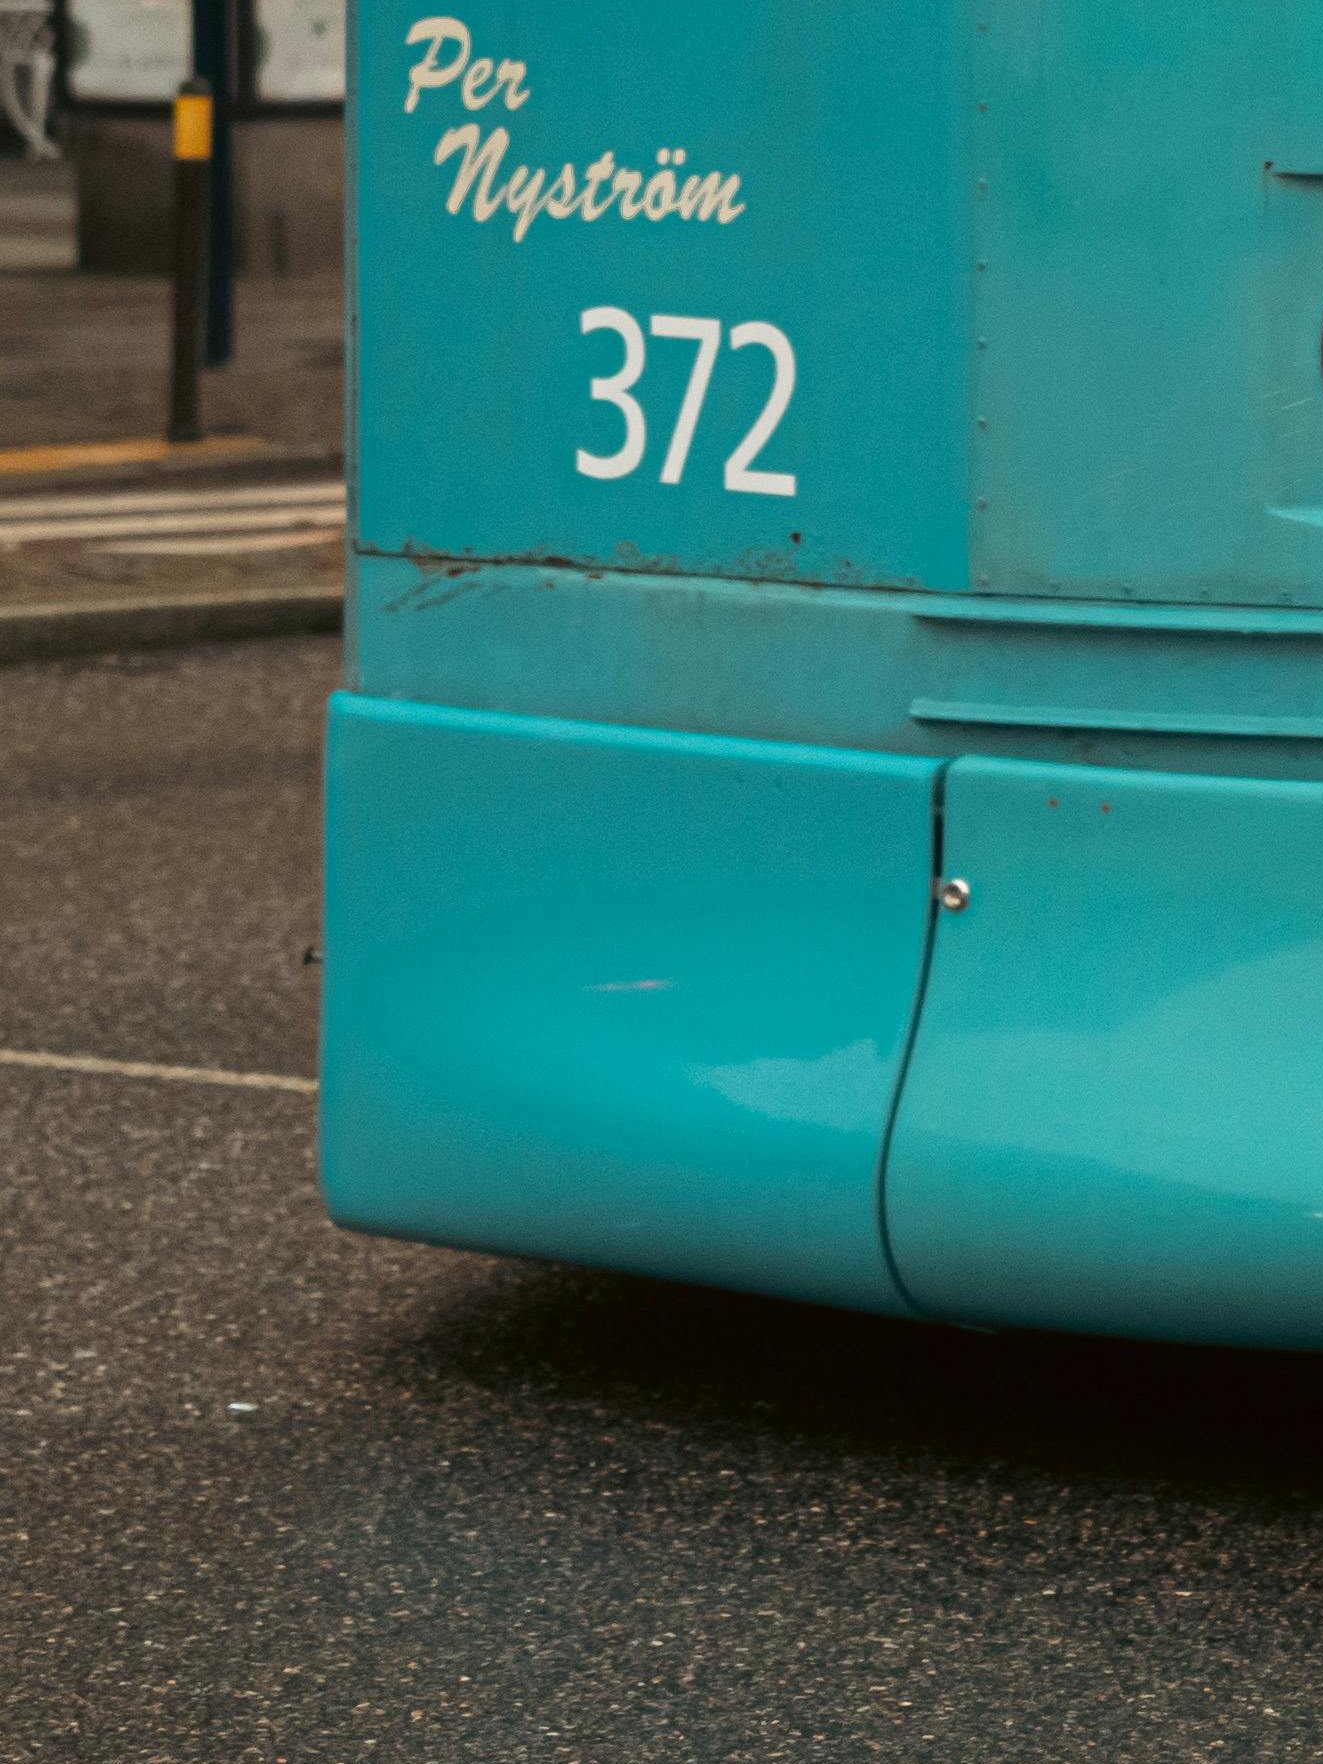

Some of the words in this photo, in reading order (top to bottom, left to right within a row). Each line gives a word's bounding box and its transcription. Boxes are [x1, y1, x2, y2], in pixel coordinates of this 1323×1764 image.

[404, 16, 530, 113] Per
[434, 123, 745, 242] Nyström
[576, 306, 796, 496] 372
